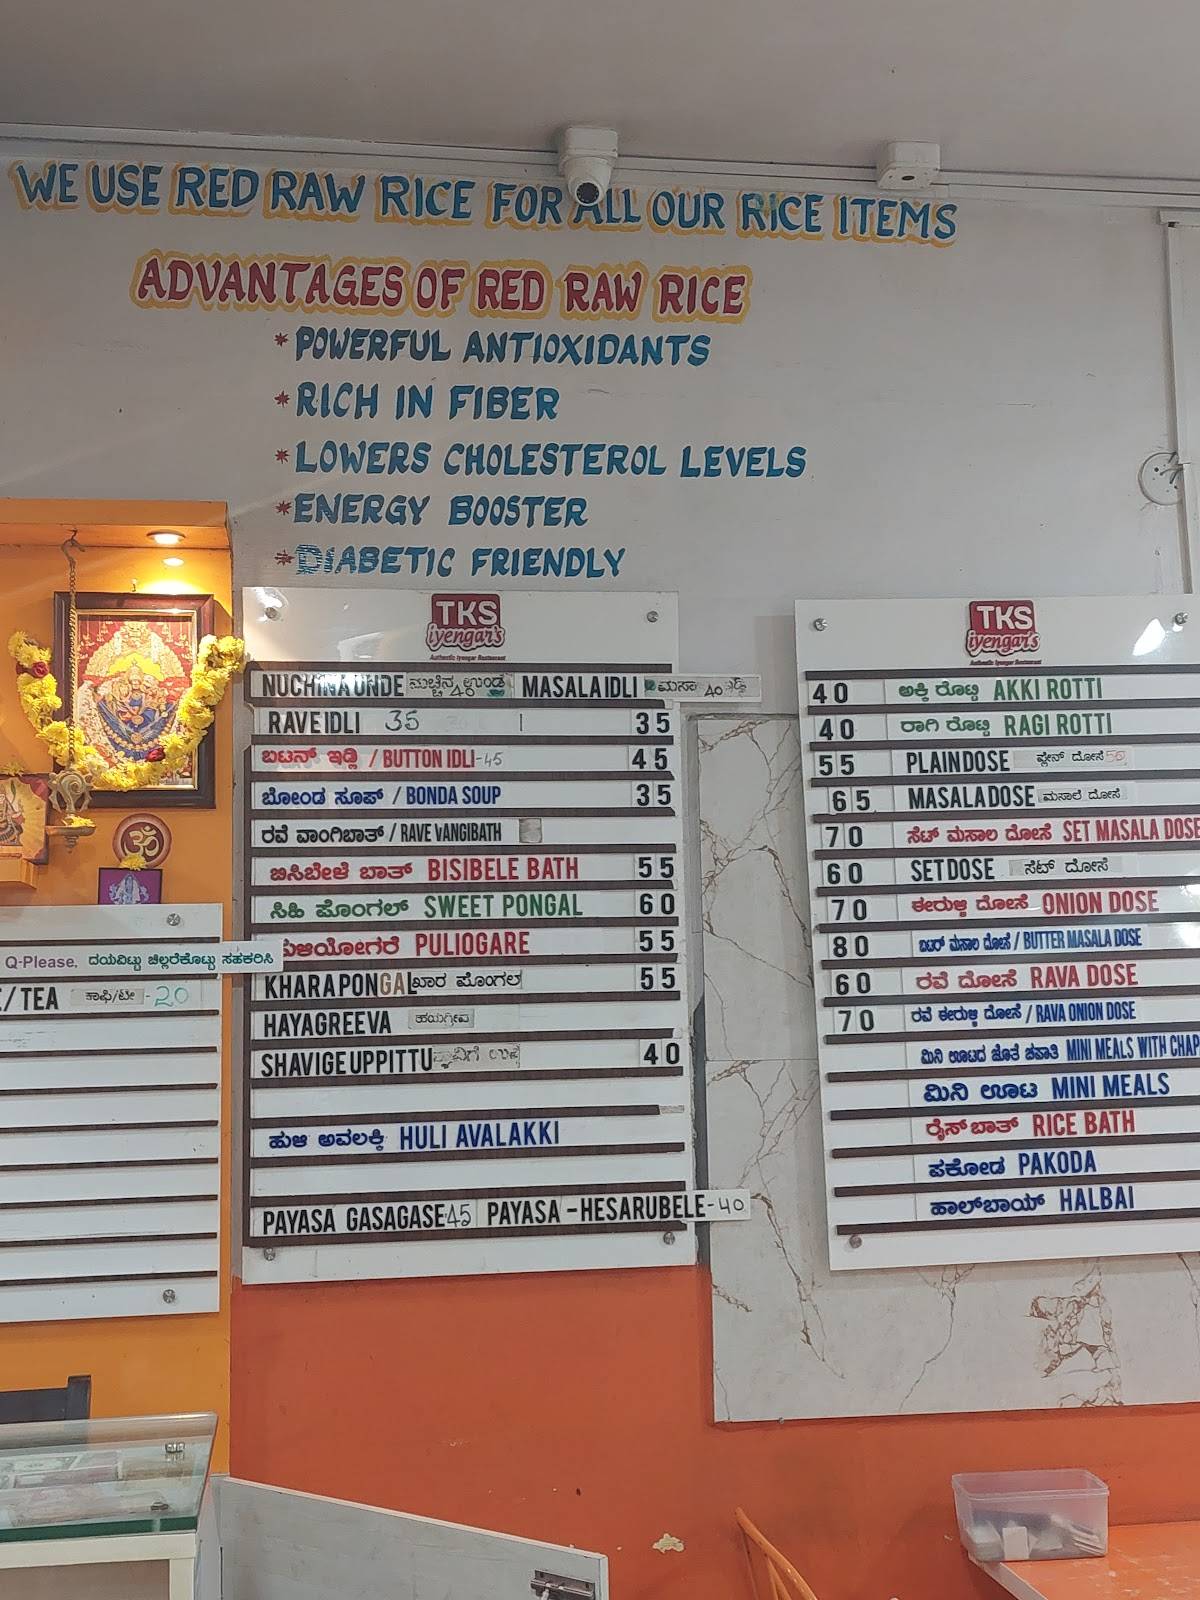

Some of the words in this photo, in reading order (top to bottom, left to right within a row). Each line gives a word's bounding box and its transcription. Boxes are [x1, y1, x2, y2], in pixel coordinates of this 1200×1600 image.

[16, 163, 77, 204] WE
[91, 164, 162, 207] USE
[176, 166, 259, 210] RED
[271, 170, 365, 213] RAW
[380, 175, 475, 219] RICE
[492, 183, 563, 224] FOR
[652, 192, 725, 230] OUR
[741, 194, 823, 234] RICE
[839, 196, 958, 239] ITEMS
[137, 258, 403, 305] ADVANTAGES
[416, 268, 465, 310] OF
[477, 269, 545, 311] RED
[564, 271, 641, 313] RAW
[658, 272, 745, 314] RICE
[295, 326, 451, 362] POWERFUL
[463, 330, 711, 367] ANTIOXIDANTS
[296, 382, 379, 419] RICH
[396, 384, 433, 419] IN
[449, 385, 560, 421] FIBER
[295, 441, 431, 475] LOWERS
[444, 443, 667, 477] CHOLESTEROL
[680, 445, 807, 479] LEVELS
[294, 493, 431, 526] ENERGY
[448, 495, 587, 528] BOOSTER
[296, 544, 455, 577] DIABETIC
[471, 546, 625, 578] FRIENDLY
[436, 601, 497, 626] TKS
[977, 606, 1033, 630] TKS
[813, 683, 848, 704] 40
[994, 679, 1040, 701] AKKI
[1047, 678, 1102, 700] ROTTI
[385, 710, 420, 731] 35
[636, 712, 670, 734] 35
[819, 719, 854, 740] 40
[1004, 714, 1049, 736] RAGI
[1057, 713, 1112, 735] ROTTI
[383, 749, 442, 768] BUTTON
[447, 749, 475, 768] IDLI
[632, 748, 668, 770] 45
[819, 754, 855, 776] 55
[406, 786, 458, 805] BONDA
[462, 786, 501, 805] SOUP
[636, 784, 671, 806] 35
[832, 790, 870, 812] 65
[401, 823, 431, 842] RAVE
[435, 823, 502, 842] VANGIBATH
[825, 826, 863, 848] 70
[1063, 820, 1090, 842] SET
[1096, 819, 1159, 841] MASALA
[1164, 817, 1200, 839] DOSE
[428, 858, 519, 881] BISIBELE
[527, 857, 579, 880] BATH
[638, 857, 674, 878] 55
[827, 863, 863, 885] 60
[424, 895, 495, 918] SWEET
[503, 893, 583, 917] PONGAL
[640, 893, 675, 915] 60
[831, 899, 867, 921] 70
[1042, 892, 1103, 915] ONION
[1109, 890, 1159, 913] DOSE
[416, 932, 530, 956] PULIOGARE
[639, 930, 674, 952] 55
[833, 935, 869, 958] 80
[1024, 930, 1065, 949] BUTTER
[1067, 929, 1112, 948] MASALA
[1115, 928, 1142, 947] DOSE
[641, 967, 676, 990] 55
[835, 972, 870, 995] 60
[1031, 965, 1080, 989] RAVA
[1087, 964, 1138, 987] DOSE
[838, 1009, 874, 1032] 70
[1036, 1004, 1066, 1023] RAVA
[1069, 1002, 1103, 1021] ONION
[1106, 1001, 1136, 1020] DOSE
[264, 1011, 391, 1037] HAYAGREEVA
[644, 1043, 680, 1065] 40
[1067, 1038, 1092, 1061] MINI
[1095, 1037, 1134, 1059] MEALS
[1137, 1035, 1167, 1058] WITH
[1052, 1075, 1095, 1100] MINI
[1102, 1072, 1170, 1097] MEALS
[1033, 1113, 1077, 1136] RICE
[1085, 1110, 1135, 1134] BATH
[400, 1125, 446, 1150] HULI
[456, 1120, 559, 1149] AVALAKKI
[1019, 1150, 1097, 1175] PAKODA
[1060, 1186, 1134, 1212] HALBAI
[263, 1208, 336, 1235] PAYASA
[347, 1204, 445, 1231] GASAGASE
[488, 1198, 560, 1225] PAYASA
